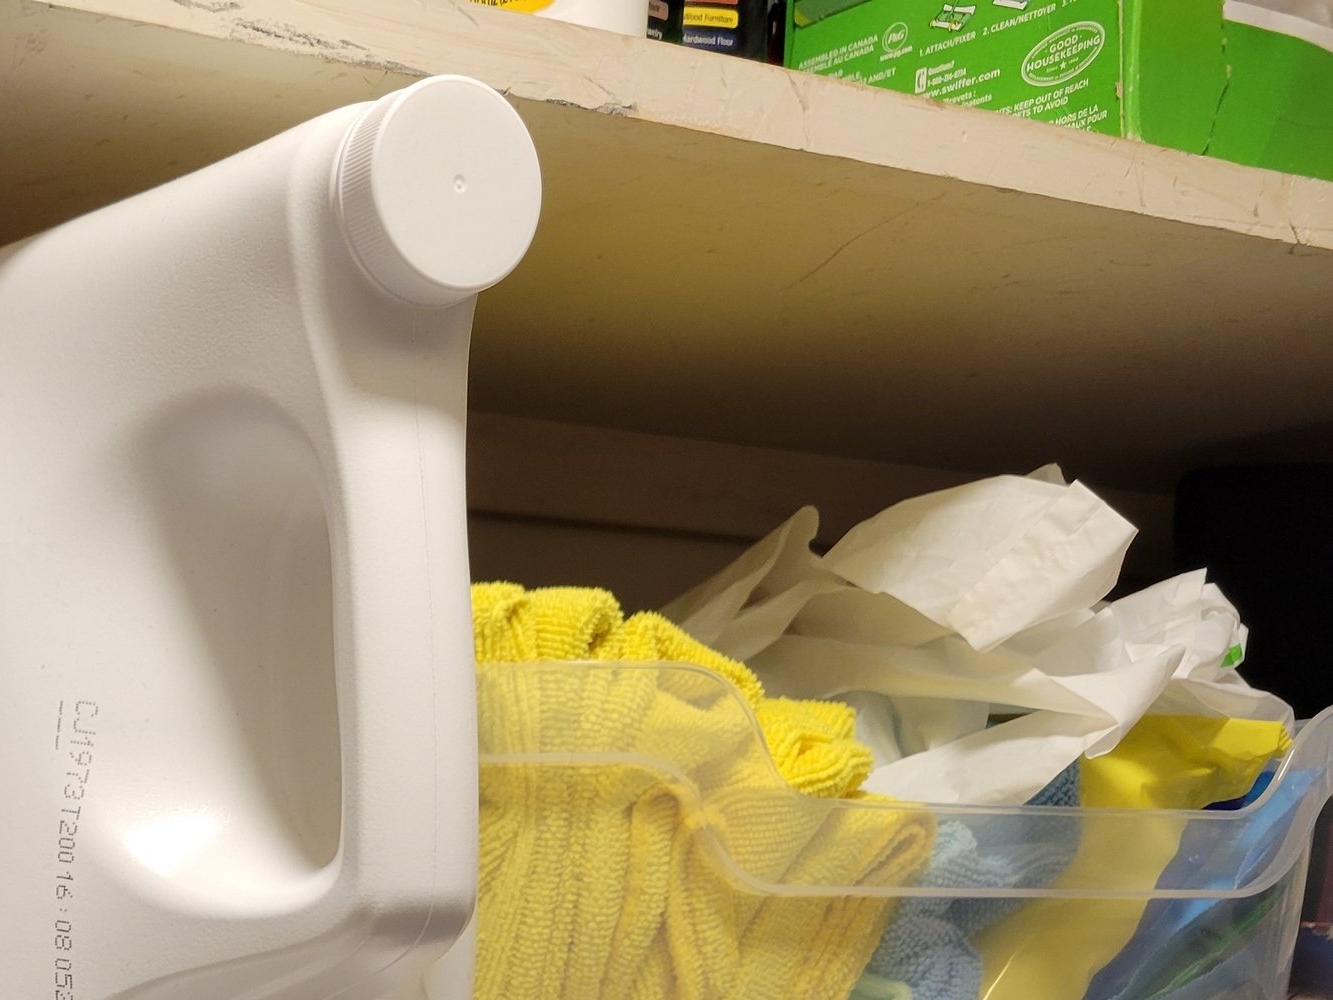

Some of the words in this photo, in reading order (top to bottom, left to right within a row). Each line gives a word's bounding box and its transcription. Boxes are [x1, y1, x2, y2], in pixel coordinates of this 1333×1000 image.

[990, 3, 1056, 32] CLEAN/NETTOYER
[798, 49, 839, 70] ASSEMBLED
[839, 45, 847, 55] IN
[847, 34, 879, 51] CANADA
[844, 44, 875, 62] CANADA
[924, 31, 976, 55] ATTACH/FIXER
[1026, 35, 1101, 73] HOUSEKEEPING
[1049, 34, 1079, 54] GOOD
[1013, 98, 1035, 112] KEEP
[1035, 92, 1052, 105] OUT
[1052, 88, 1064, 99] OF
[1064, 78, 1089, 95] REACH
[1032, 104, 1044, 115] TO
[1044, 96, 1069, 110] AVOID
[1055, 112, 1077, 125] HORS
[1077, 108, 1088, 118] DE
[1089, 104, 1099, 115] LA
[1087, 109, 1108, 125] POUR
